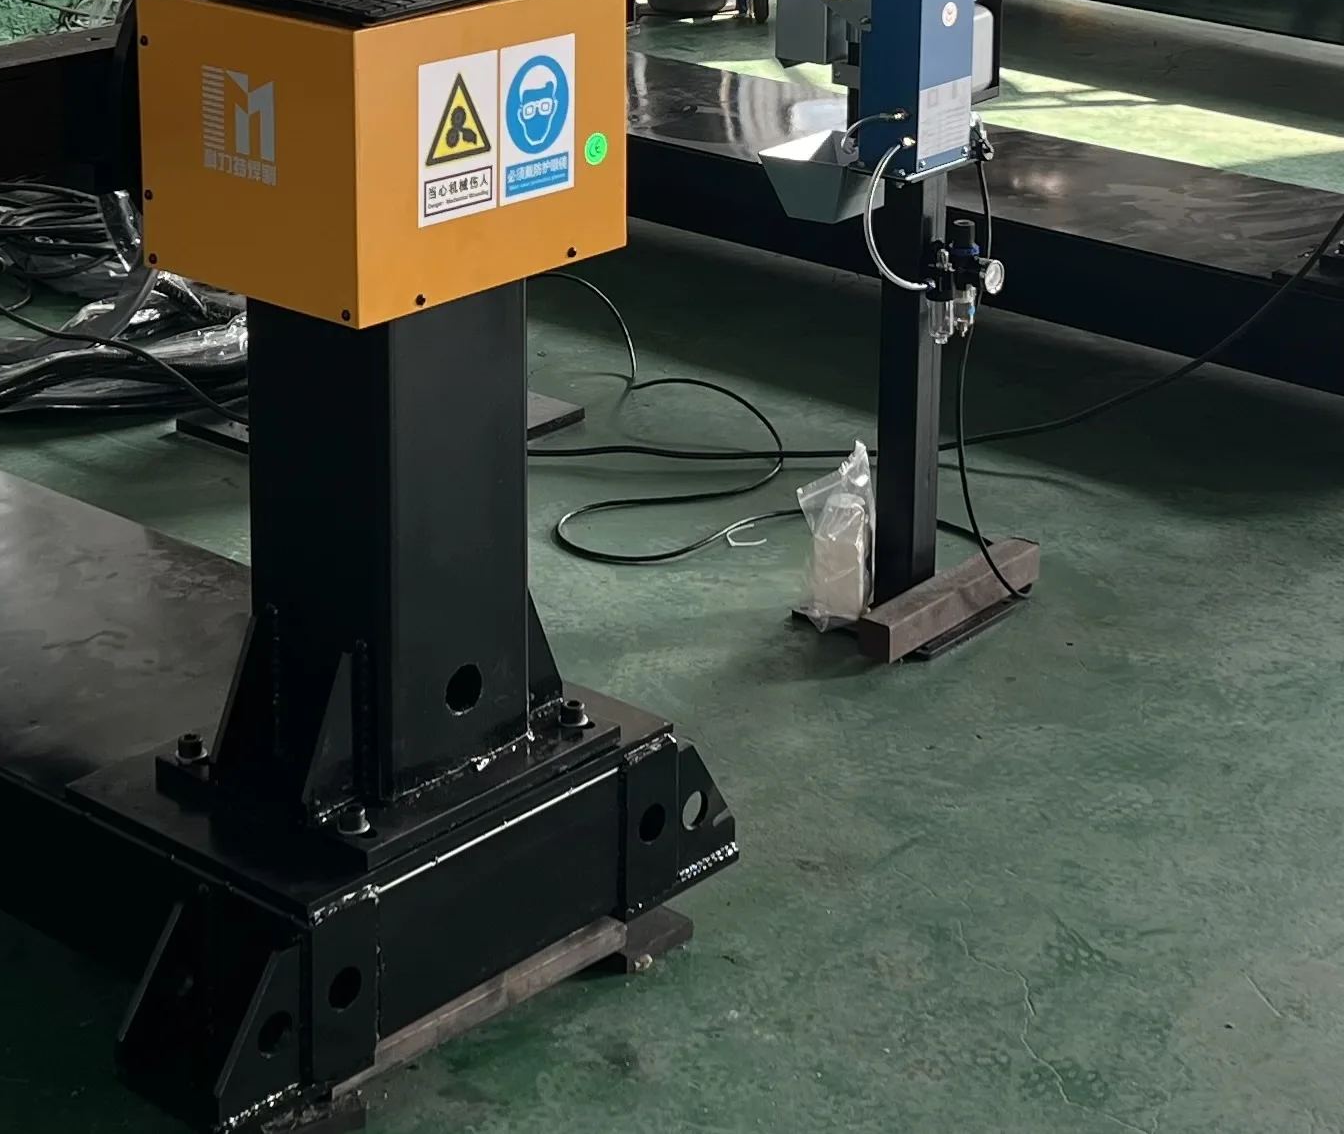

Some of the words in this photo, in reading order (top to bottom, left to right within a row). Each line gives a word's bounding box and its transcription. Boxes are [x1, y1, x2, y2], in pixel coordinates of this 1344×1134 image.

[427, 173, 489, 200] 当心机械伤人
